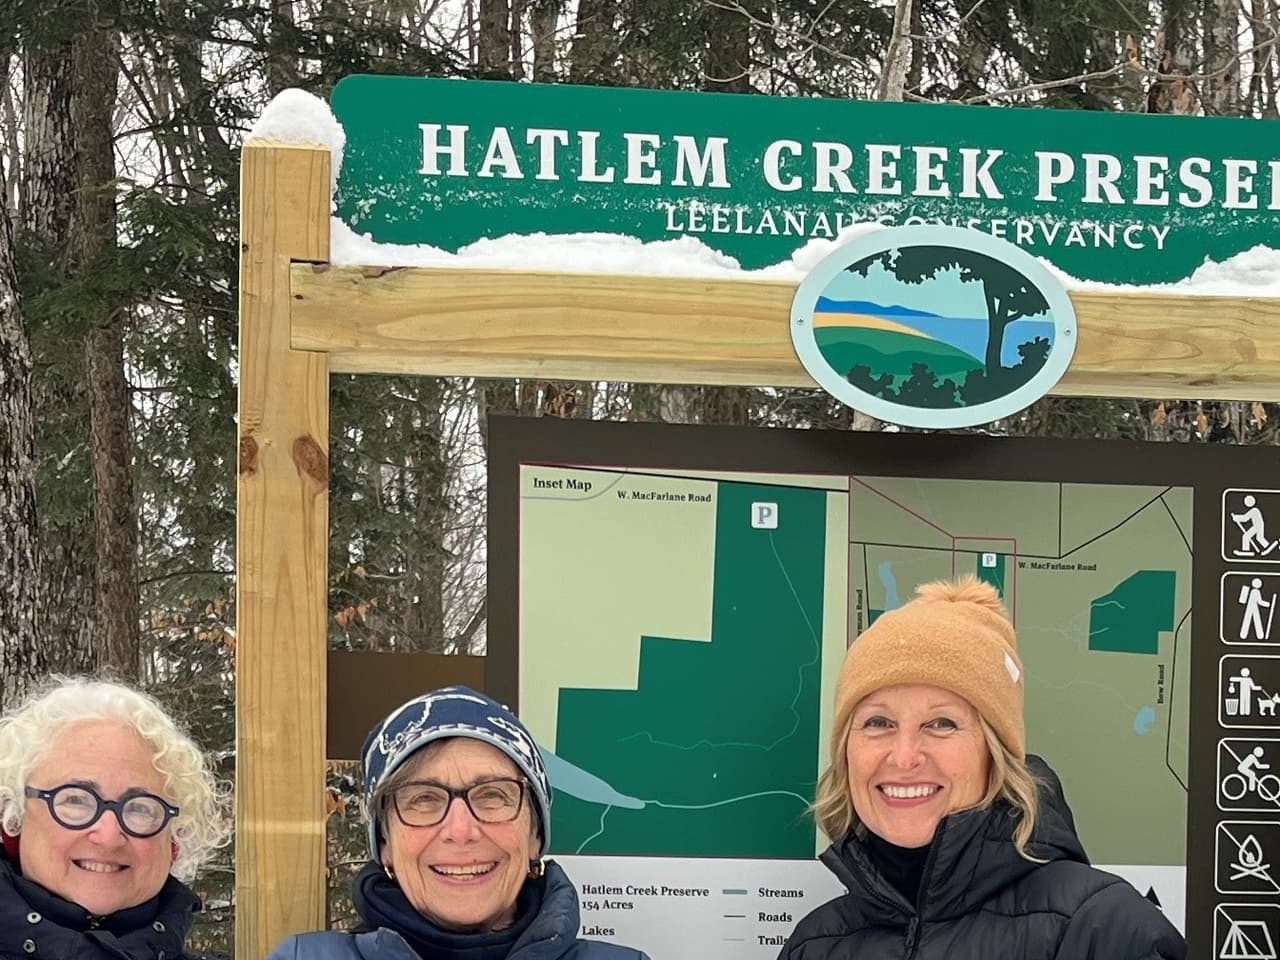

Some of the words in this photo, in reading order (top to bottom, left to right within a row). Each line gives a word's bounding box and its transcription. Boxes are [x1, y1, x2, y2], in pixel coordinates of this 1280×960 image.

[418, 123, 731, 189] HATLEM
[763, 140, 1004, 200] CREEK
[533, 478, 563, 489] Inset
[566, 479, 592, 492] Map
[617, 490, 630, 499] W.
[632, 492, 686, 501] MacFarlane
[688, 493, 712, 502] Road
[757, 506, 772, 524] P
[1031, 562, 1075, 571] MacFarlane
[1077, 563, 1097, 571] Road
[582, 884, 623, 895] Hatlem
[625, 885, 658, 896] Creek
[661, 886, 710, 896] Preserve
[758, 887, 804, 898] Streams
[582, 901, 599, 911] 154
[602, 900, 634, 910] Acres
[758, 912, 793, 922] Roads
[582, 925, 615, 936] Lakes
